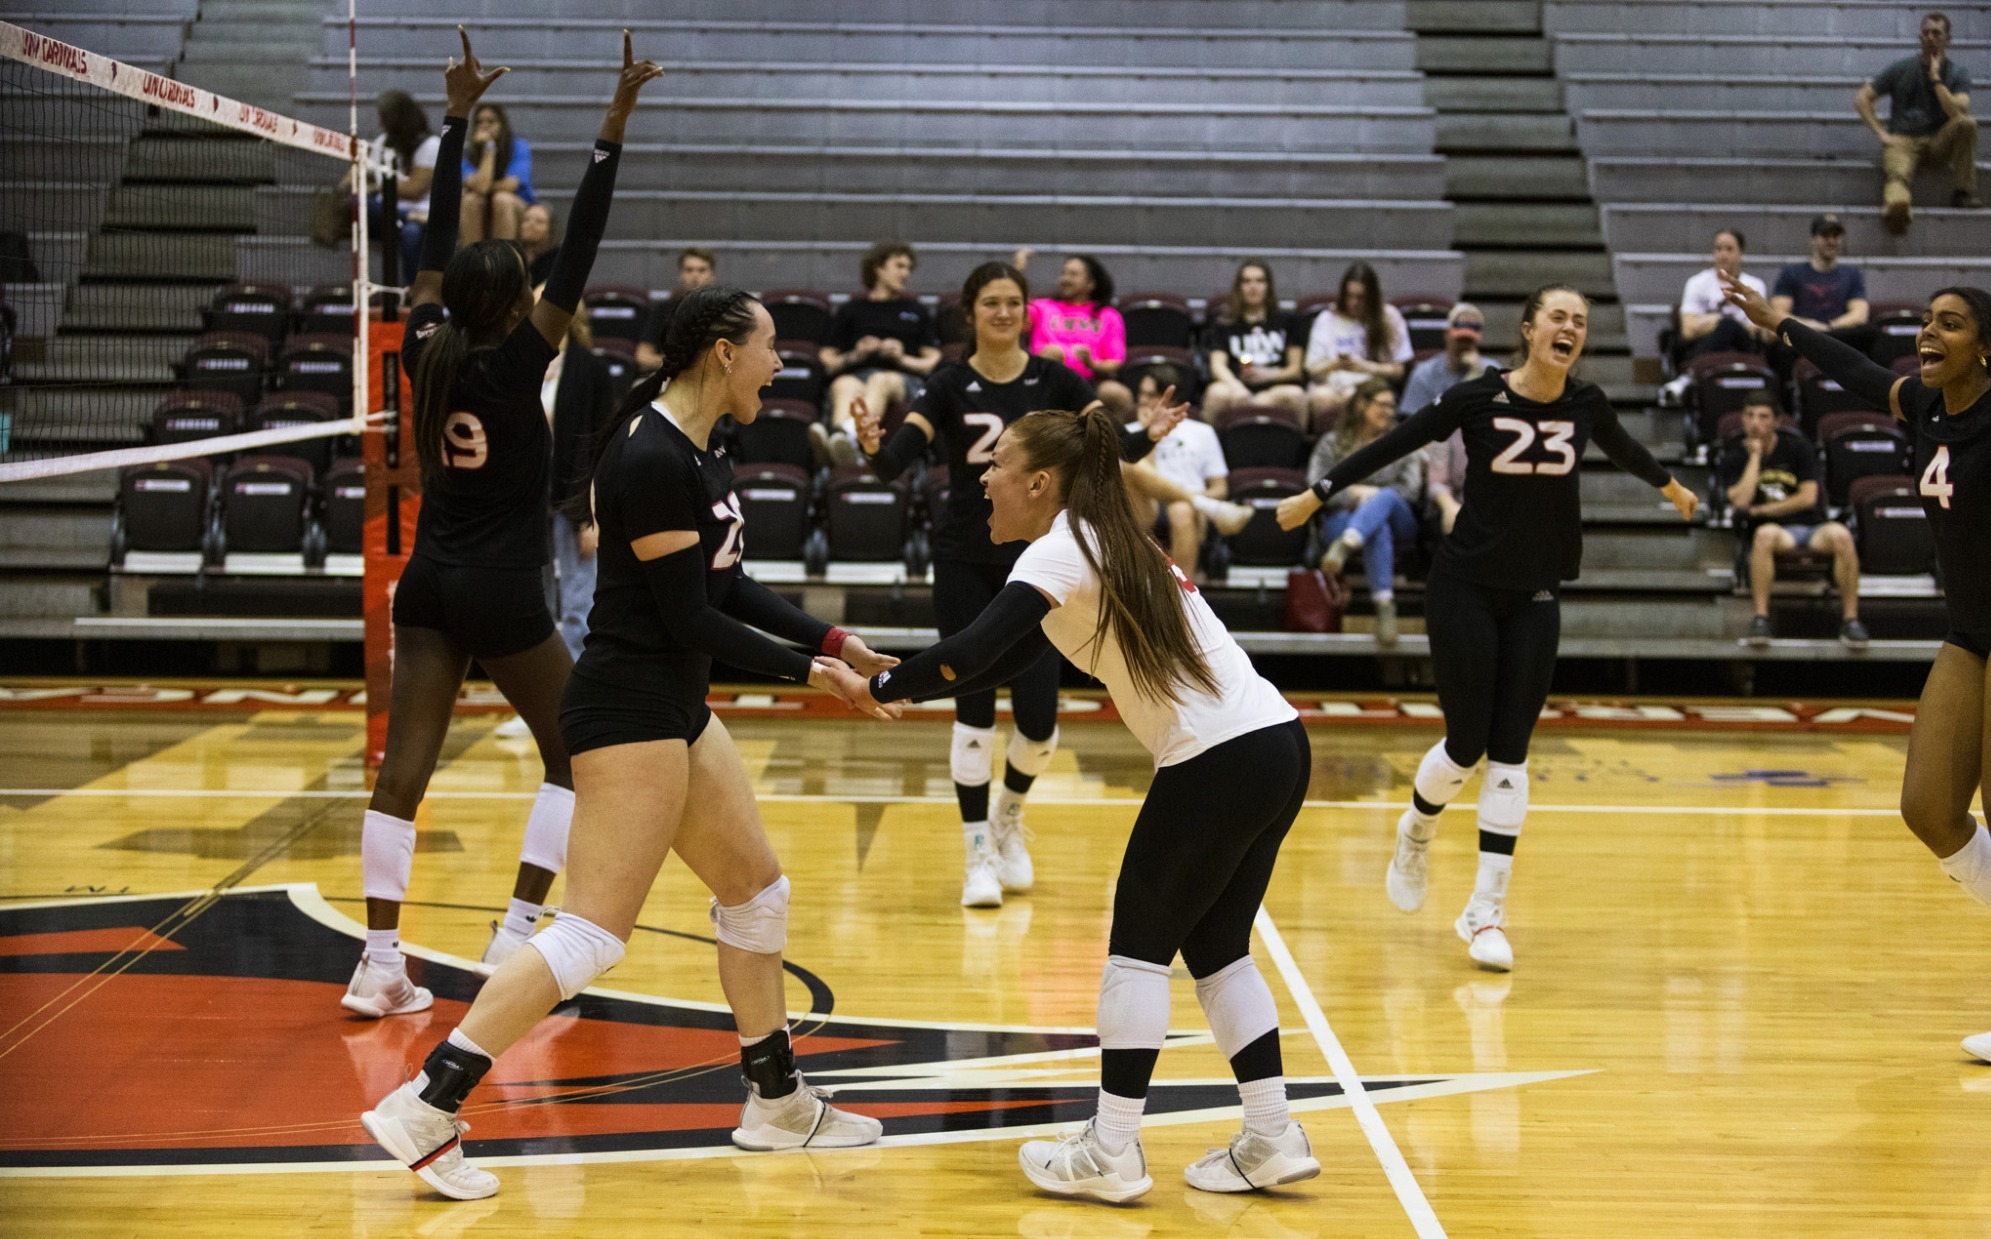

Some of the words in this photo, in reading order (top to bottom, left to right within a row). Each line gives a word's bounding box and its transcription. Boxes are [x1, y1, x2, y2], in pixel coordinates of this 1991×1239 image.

[963, 412, 1004, 464] 2
[1491, 417, 1576, 475] 23
[1919, 445, 1954, 510] 4
